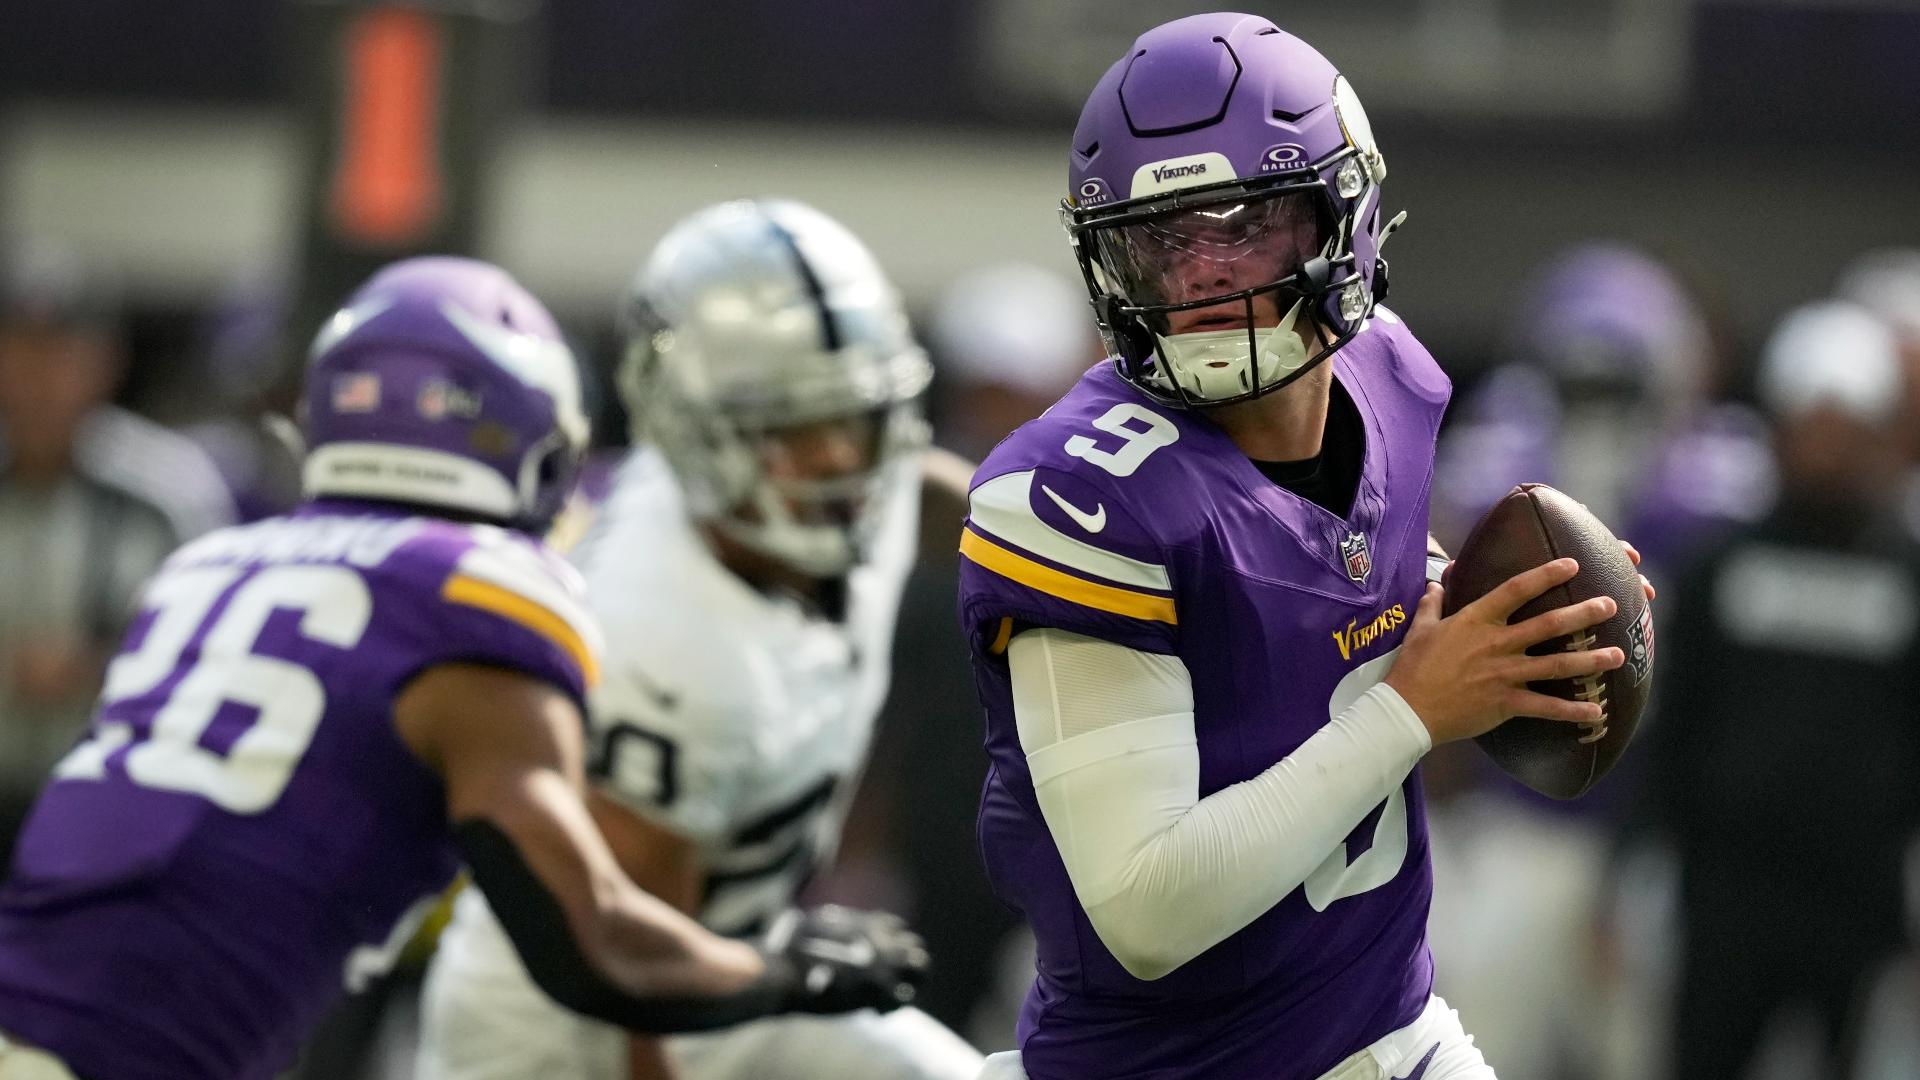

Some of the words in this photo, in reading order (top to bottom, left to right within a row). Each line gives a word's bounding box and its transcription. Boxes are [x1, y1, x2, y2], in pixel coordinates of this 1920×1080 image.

[1262, 161, 1308, 171] OAKLEY
[1064, 403, 1180, 477] 9
[1349, 554, 1370, 576] NFL
[52, 563, 373, 814] 26
